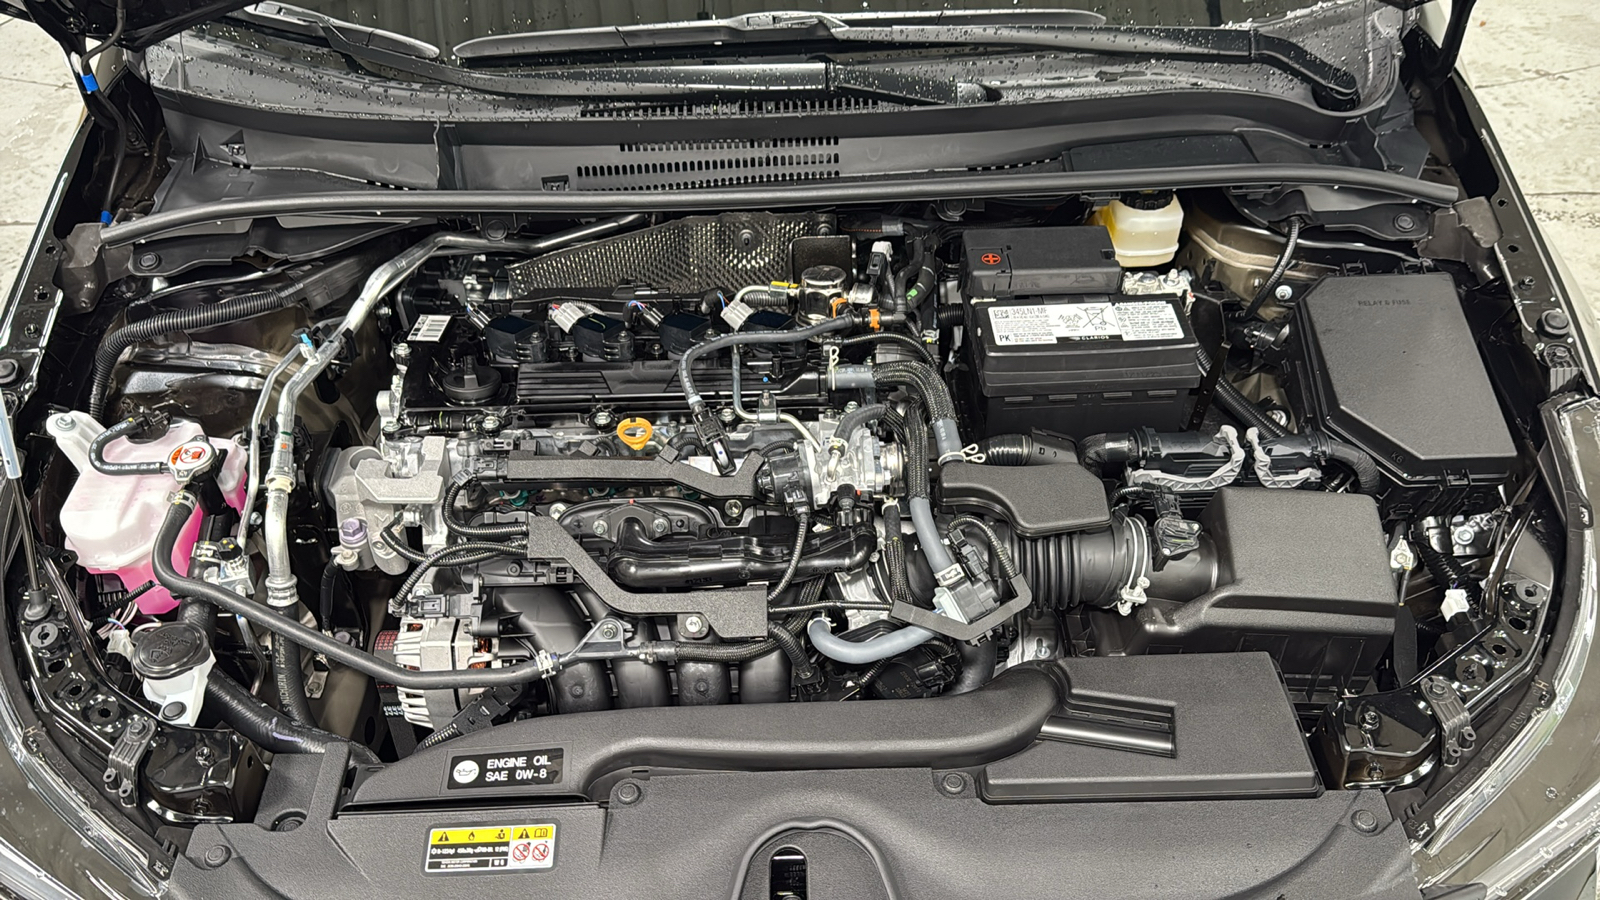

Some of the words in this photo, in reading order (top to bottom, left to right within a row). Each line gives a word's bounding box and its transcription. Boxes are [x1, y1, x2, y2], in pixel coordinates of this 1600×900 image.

[999, 334, 1011, 342] PK
[487, 757, 527, 769] ENGINE
[533, 755, 552, 765] OIL
[485, 771, 509, 782] SAE
[515, 768, 547, 780] 0W-8
